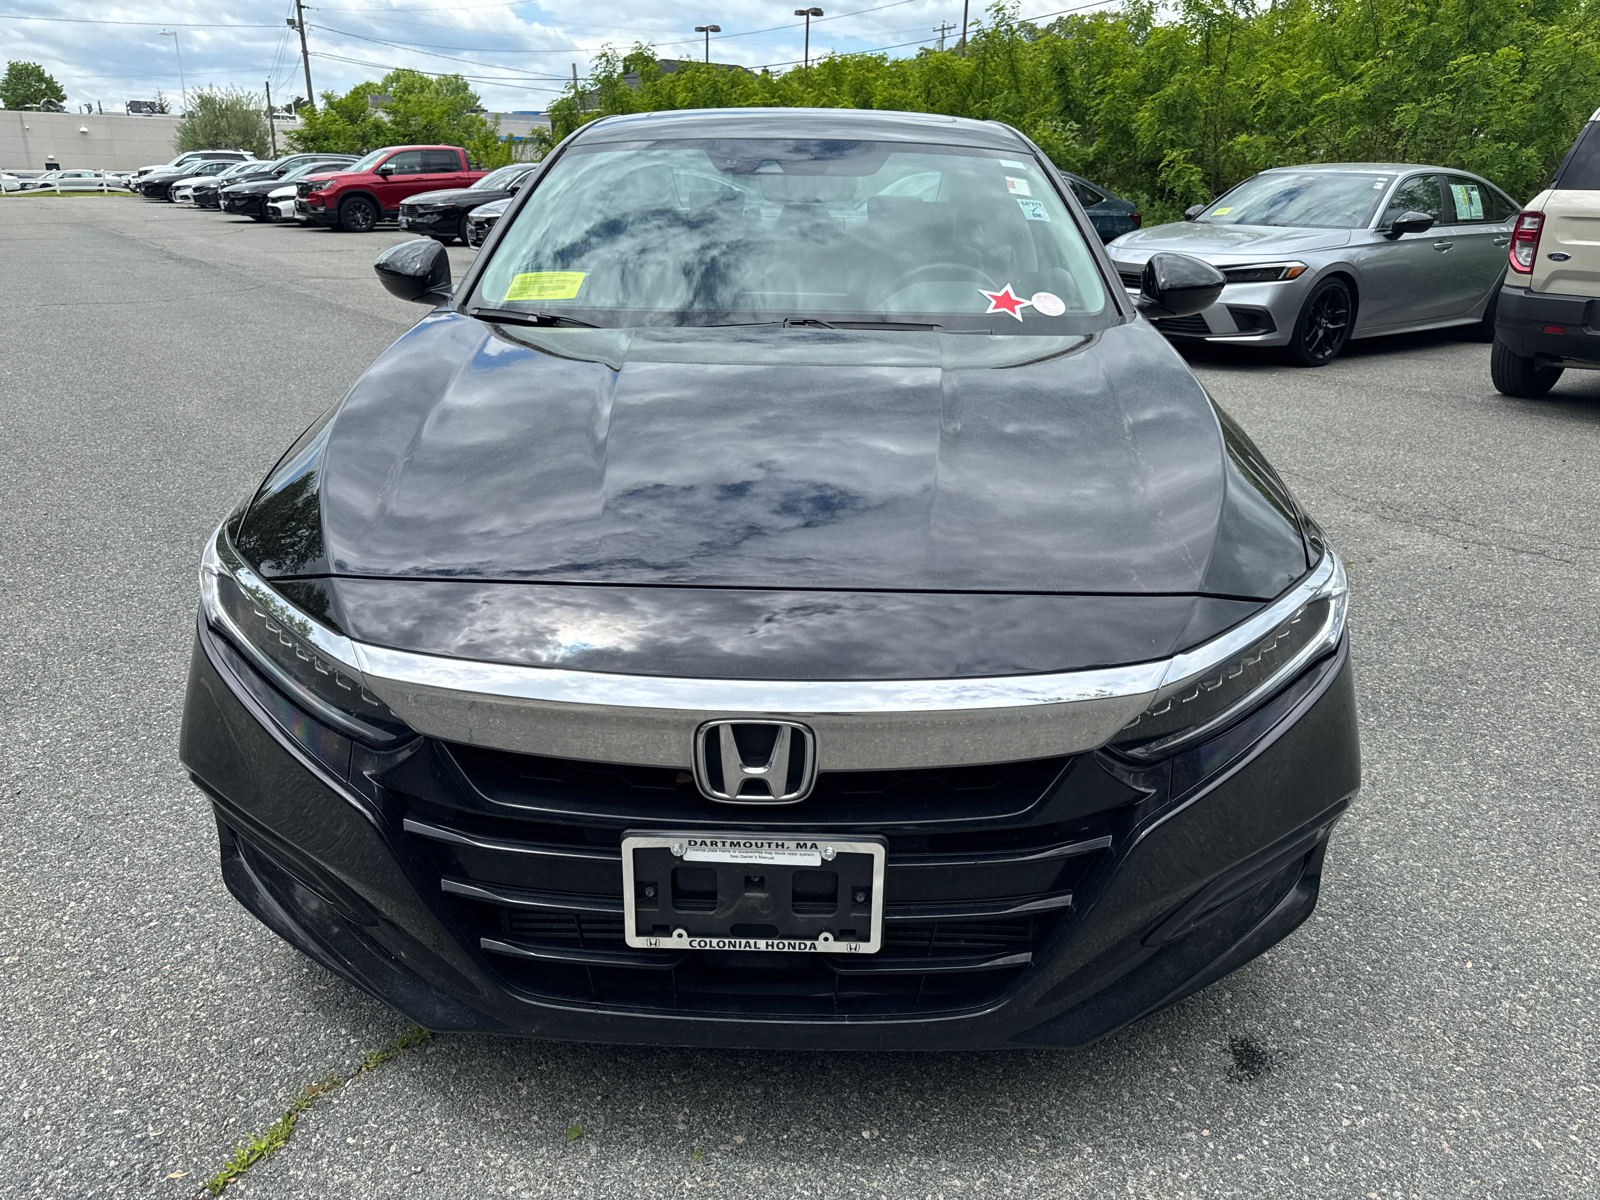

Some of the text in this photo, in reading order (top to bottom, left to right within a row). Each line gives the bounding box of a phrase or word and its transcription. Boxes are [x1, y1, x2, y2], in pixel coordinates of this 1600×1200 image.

[688, 840, 790, 850] DARTMOUTH,
[688, 939, 818, 951] COLONIAL HONDA
